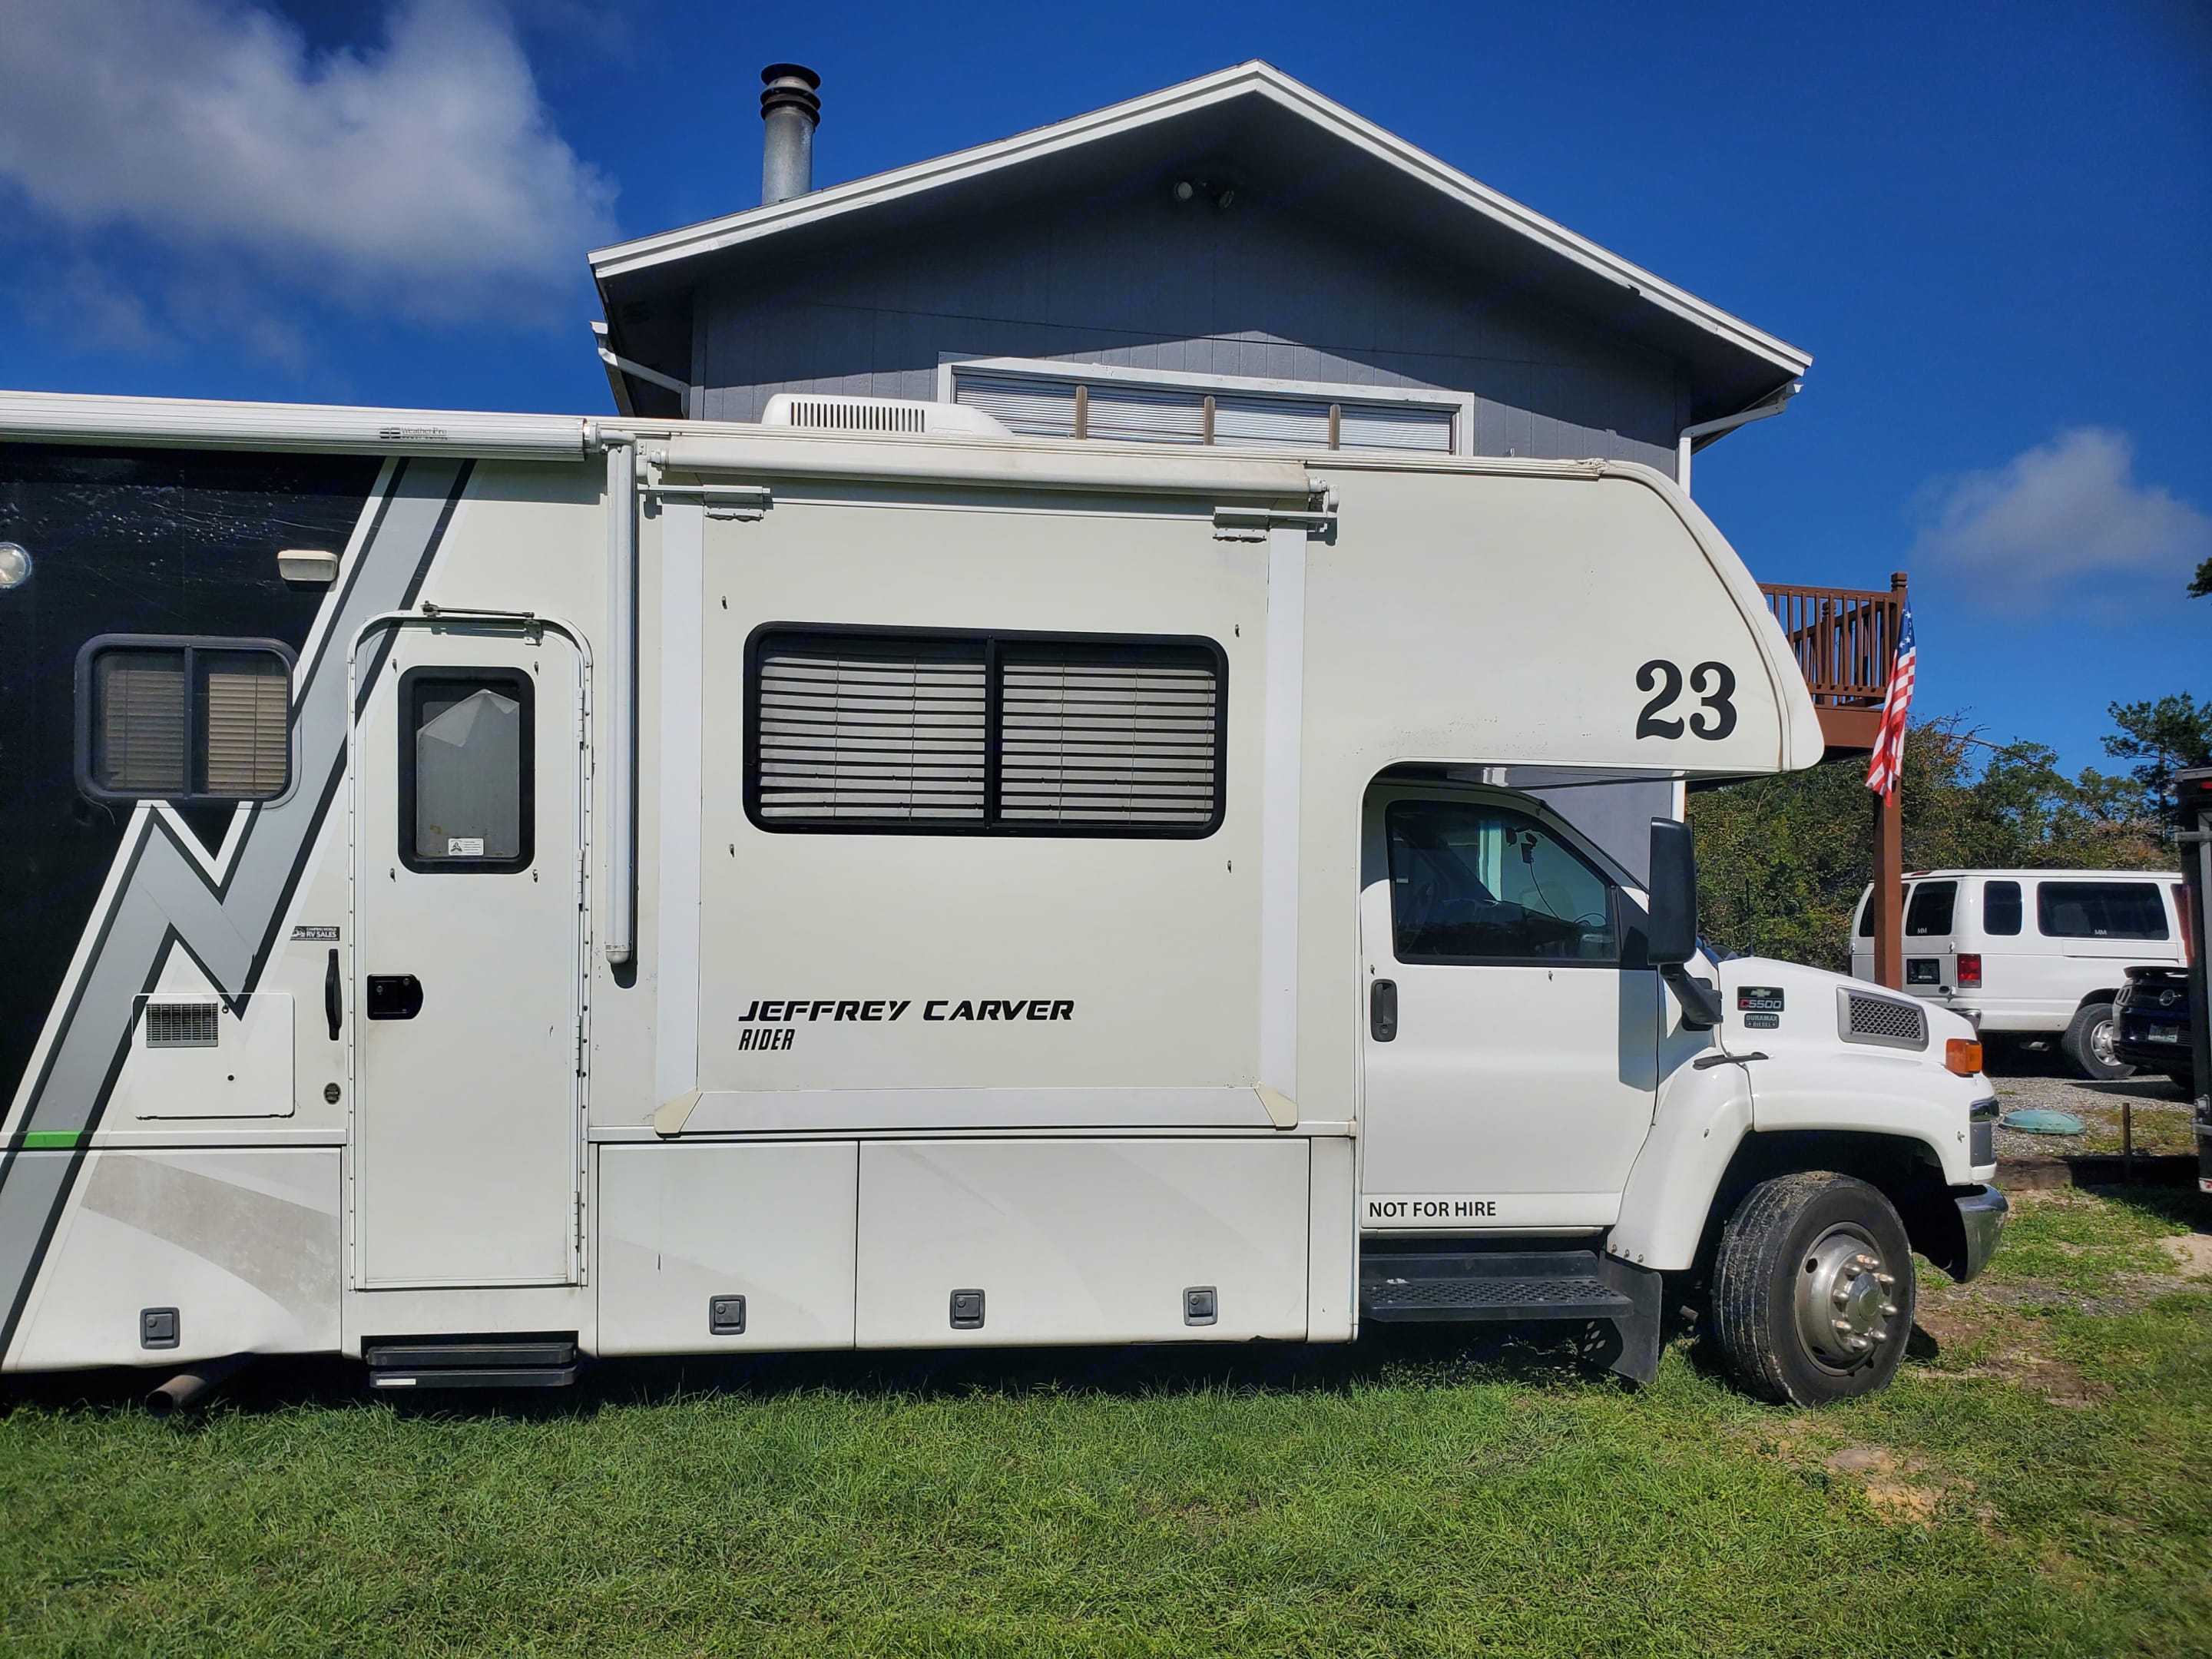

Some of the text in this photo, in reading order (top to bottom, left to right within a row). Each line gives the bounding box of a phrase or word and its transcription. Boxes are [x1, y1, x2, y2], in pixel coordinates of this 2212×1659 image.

[1636, 660, 1737, 740] 23
[738, 1000, 1075, 1022] JEFFREY CARVER
[1740, 999, 1782, 1009] C5500
[738, 1029, 796, 1051] RIDER
[1369, 1201, 1496, 1217] NOT FOR HIRE
